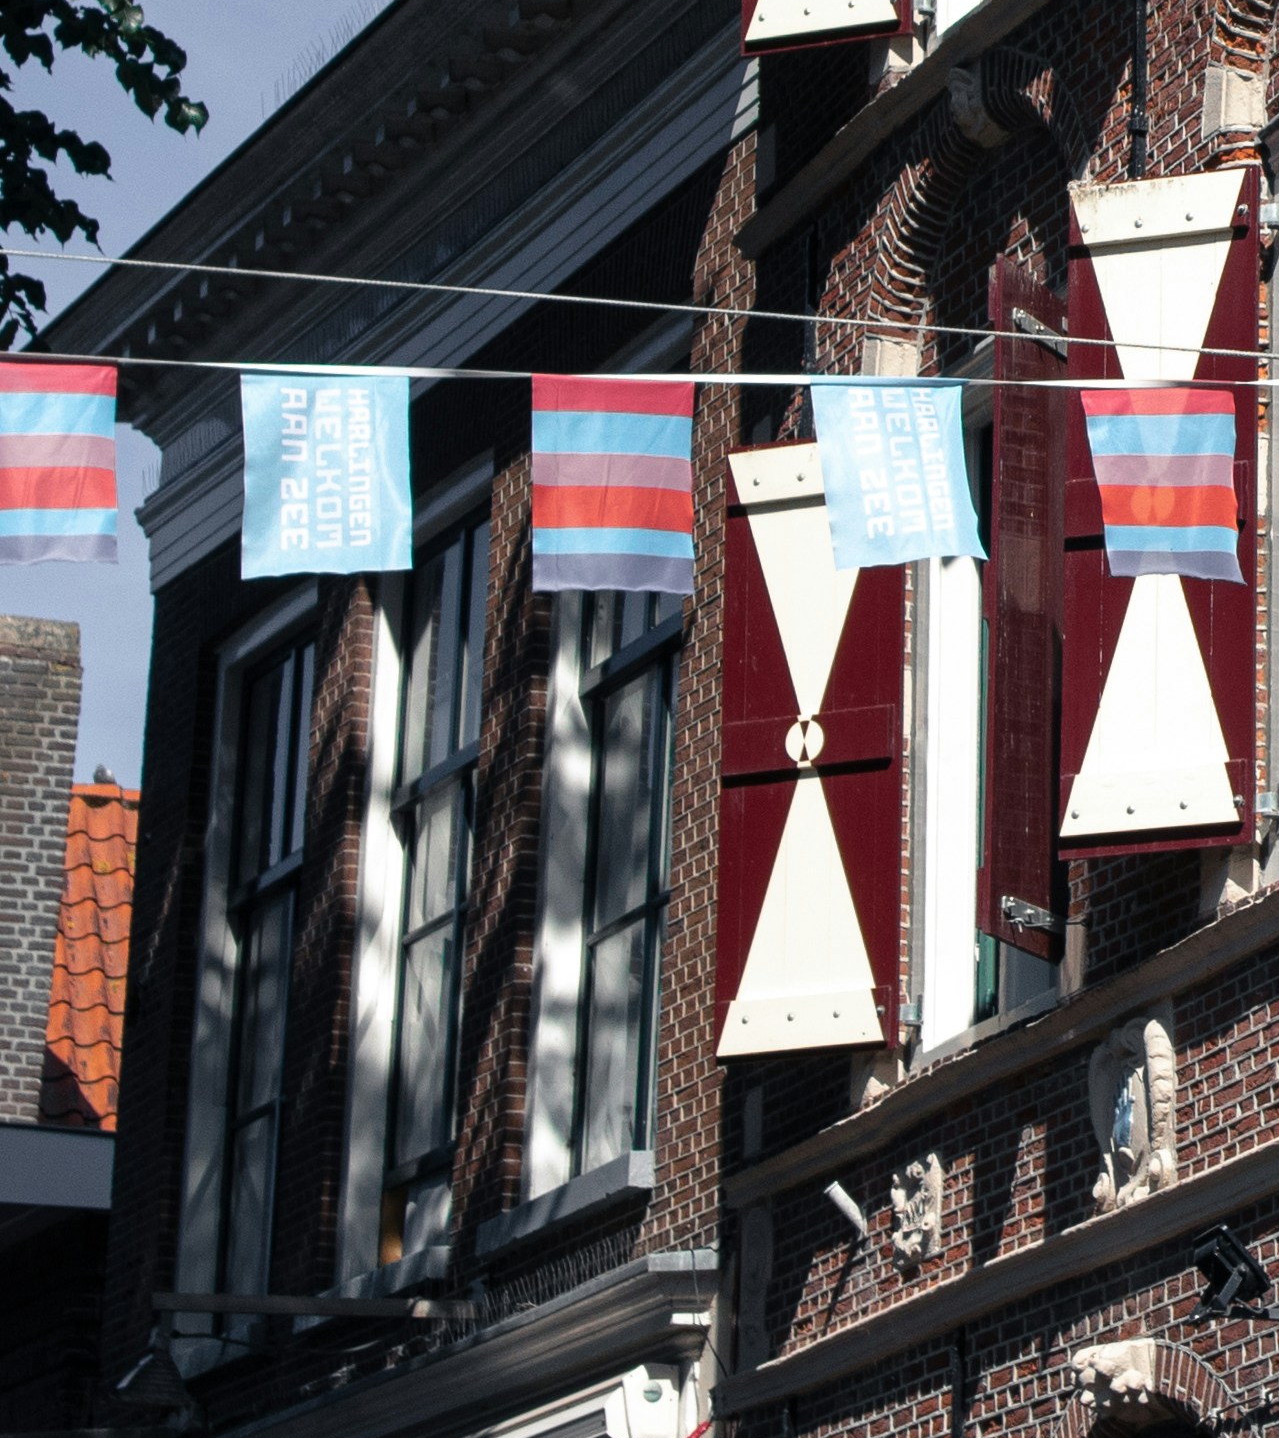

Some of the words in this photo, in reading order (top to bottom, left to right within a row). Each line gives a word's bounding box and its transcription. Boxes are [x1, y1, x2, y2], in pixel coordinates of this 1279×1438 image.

[280, 387, 308, 462] AAN
[315, 389, 343, 549] WELKOM
[348, 388, 372, 547] HARLINGEN
[848, 389, 883, 456] AAN
[880, 389, 928, 535] WELKOM
[910, 388, 955, 531] HARLINGEN
[280, 478, 309, 551] ZEE
[859, 468, 894, 539] ZEE
